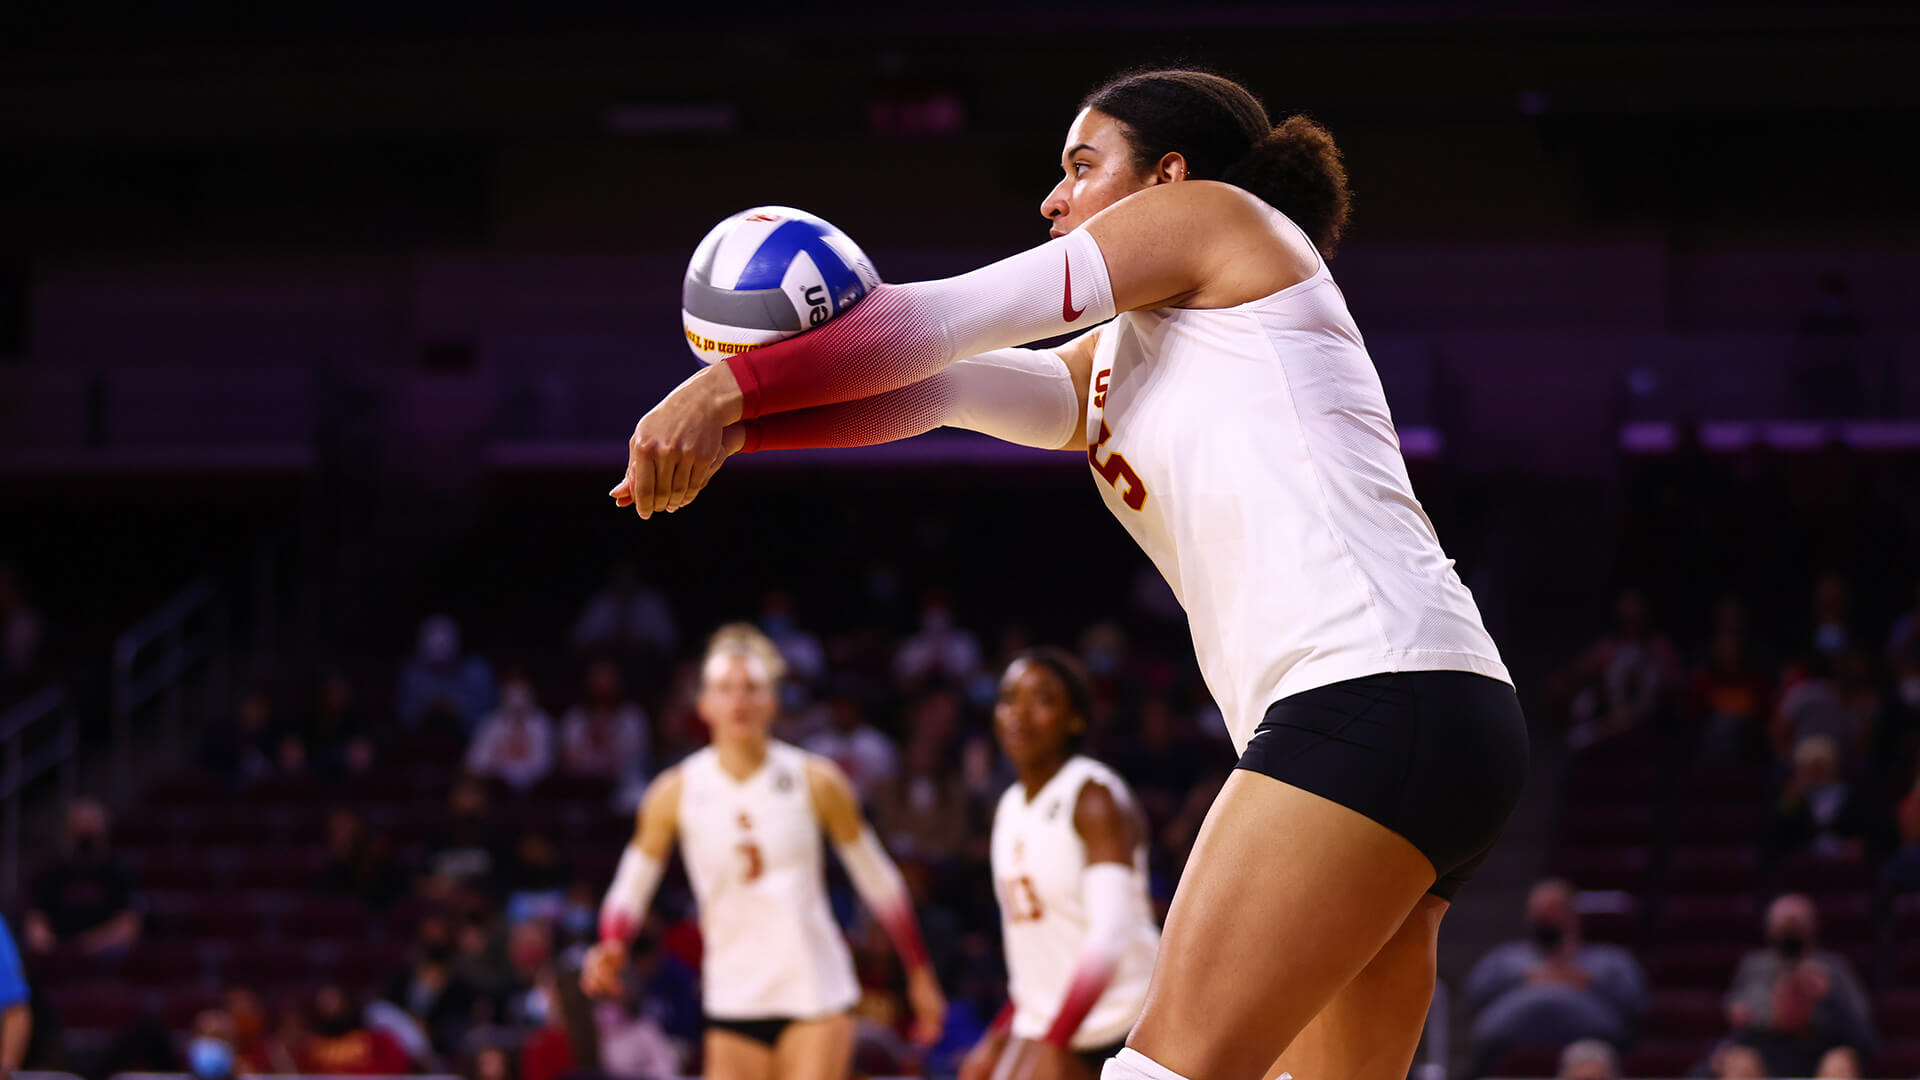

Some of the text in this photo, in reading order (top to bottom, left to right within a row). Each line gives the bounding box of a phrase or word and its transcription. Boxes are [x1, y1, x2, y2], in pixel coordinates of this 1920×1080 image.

[703, 337, 716, 352] of
[718, 341, 767, 355] omen
[1088, 417, 1149, 513] 5
